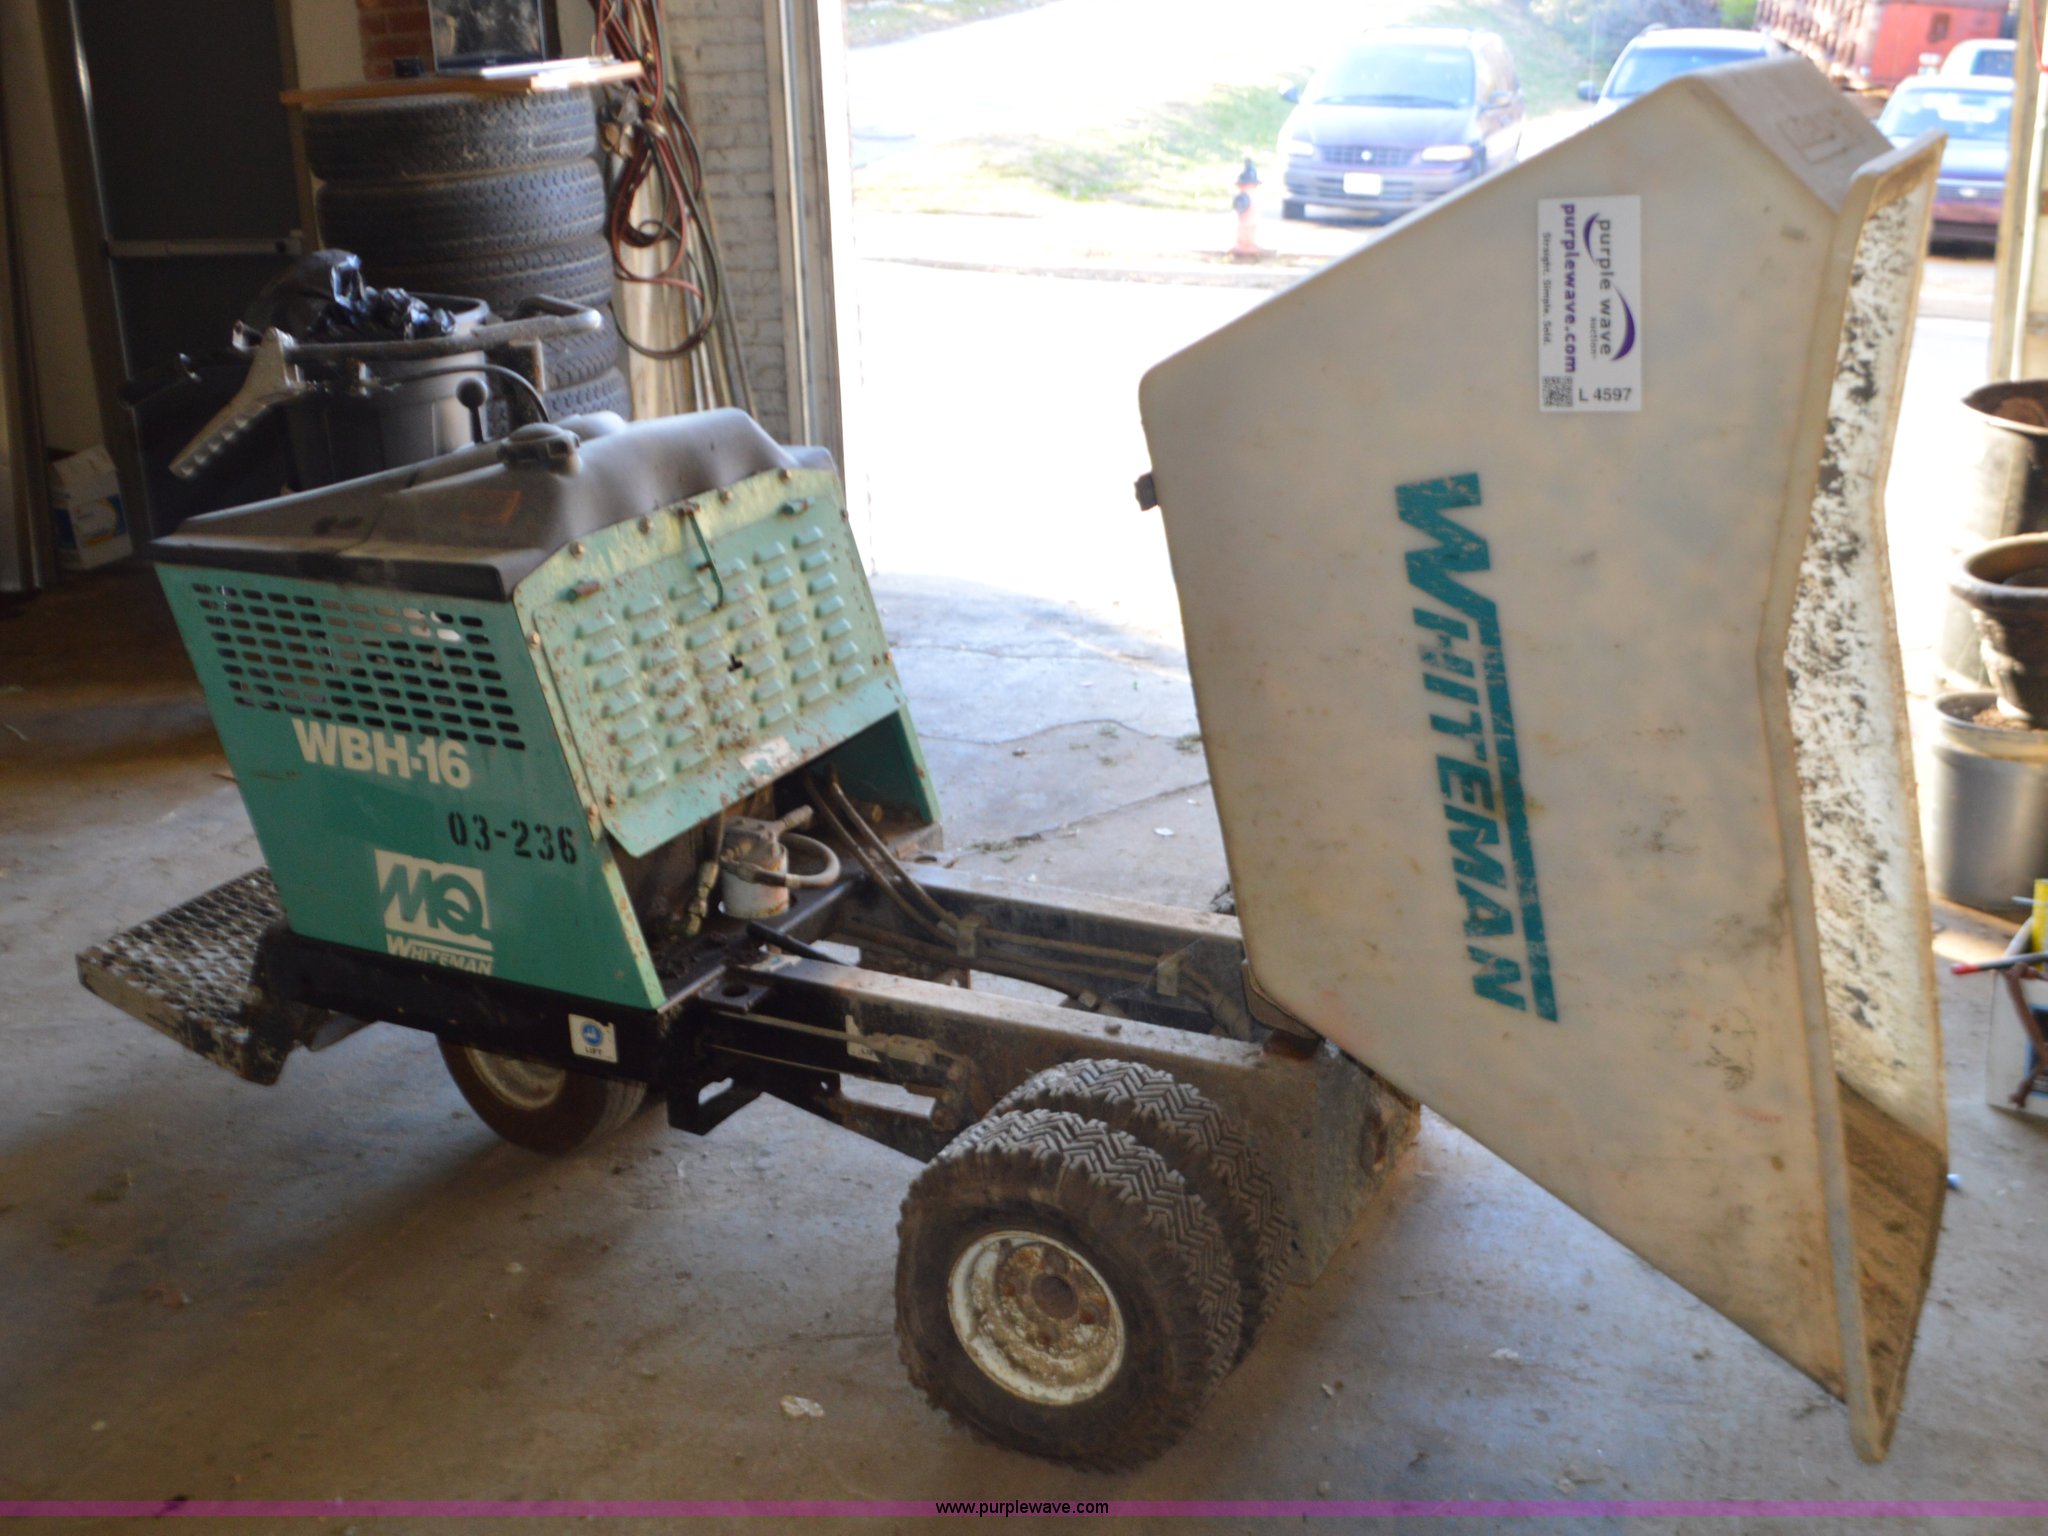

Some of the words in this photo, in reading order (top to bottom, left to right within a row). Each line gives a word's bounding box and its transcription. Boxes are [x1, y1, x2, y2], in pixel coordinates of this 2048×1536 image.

[1595, 219, 1615, 291] purple
[1560, 203, 1580, 374] purplewave.com
[1599, 298, 1612, 356] wave
[1578, 388, 1589, 402] L
[1593, 387, 1633, 402] 4597
[292, 717, 471, 790] WBH-16
[1395, 471, 1558, 1023] WHITEMAN
[447, 811, 577, 865] 03-236
[385, 933, 495, 977] WHITEMAN
